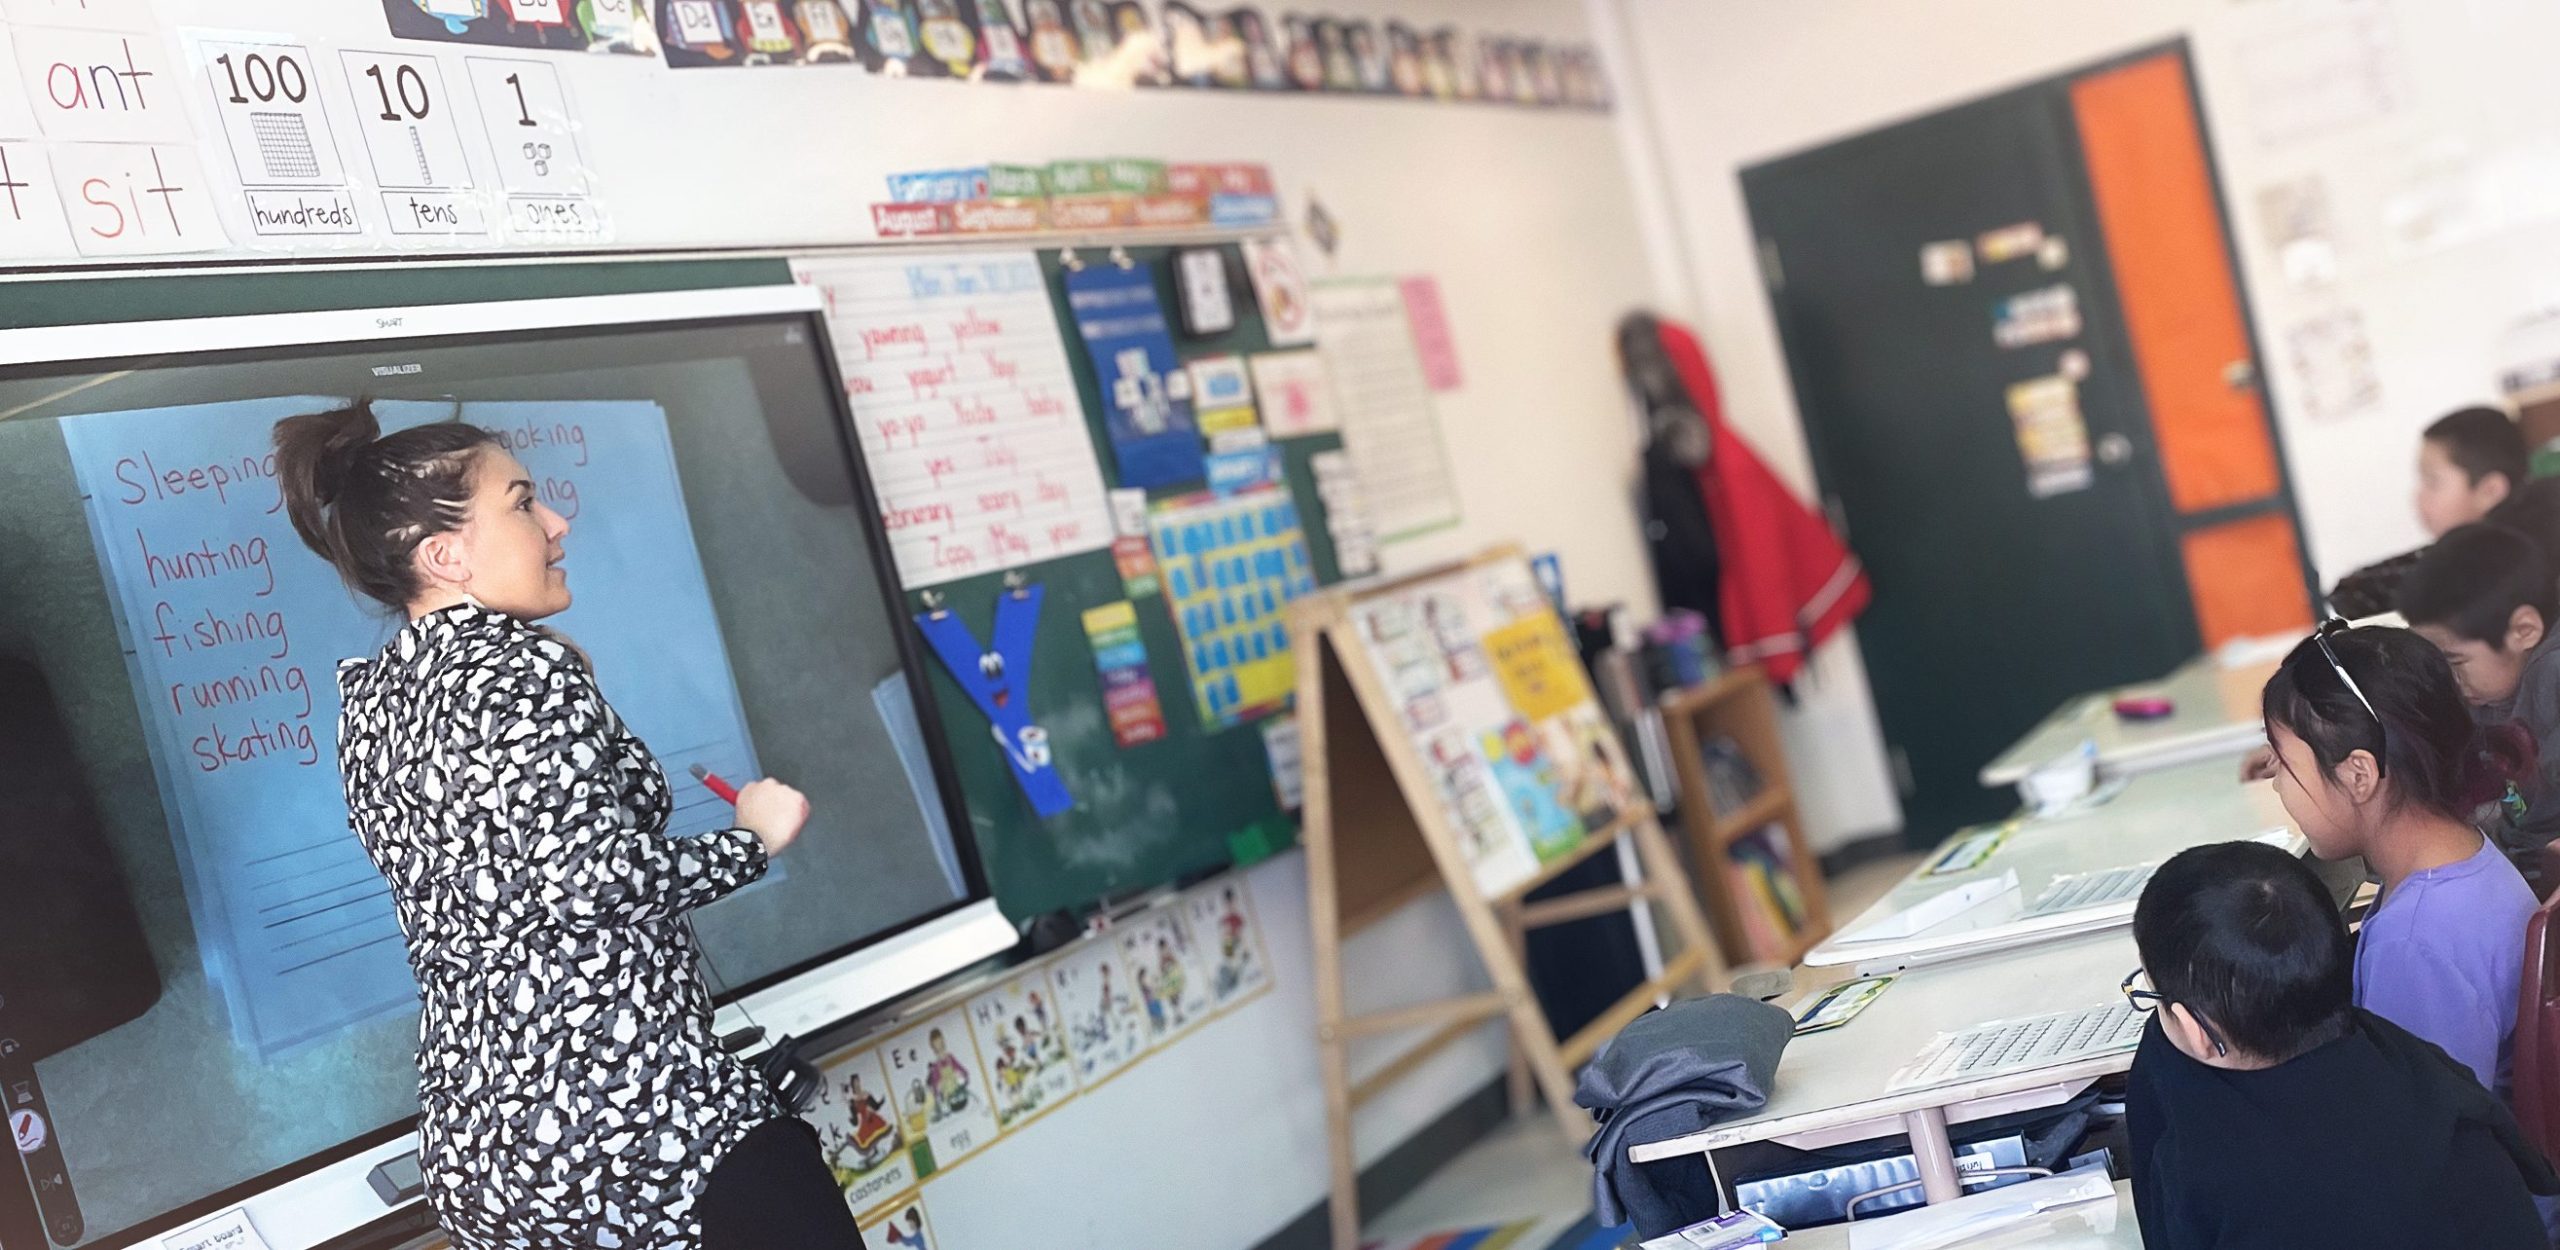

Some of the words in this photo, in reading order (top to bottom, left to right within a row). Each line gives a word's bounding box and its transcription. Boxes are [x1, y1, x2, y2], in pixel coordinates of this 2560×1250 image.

[682, 3, 712, 29] Dd
[48, 38, 153, 110] ant
[216, 53, 307, 103] 100
[365, 64, 430, 121] 10
[506, 72, 537, 127] 1
[82, 147, 184, 238] sit
[251, 195, 353, 228] hundreds
[409, 196, 458, 229] tens
[526, 203, 582, 225] ones
[875, 204, 938, 236] August
[376, 317, 403, 329] SMART
[115, 450, 286, 514] Sleeping
[136, 528, 274, 597] hunting
[154, 602, 289, 659] fishing
[171, 666, 312, 719] running
[192, 717, 319, 773] skating
[892, 1050, 904, 1069] E
[909, 1049, 918, 1062] e
